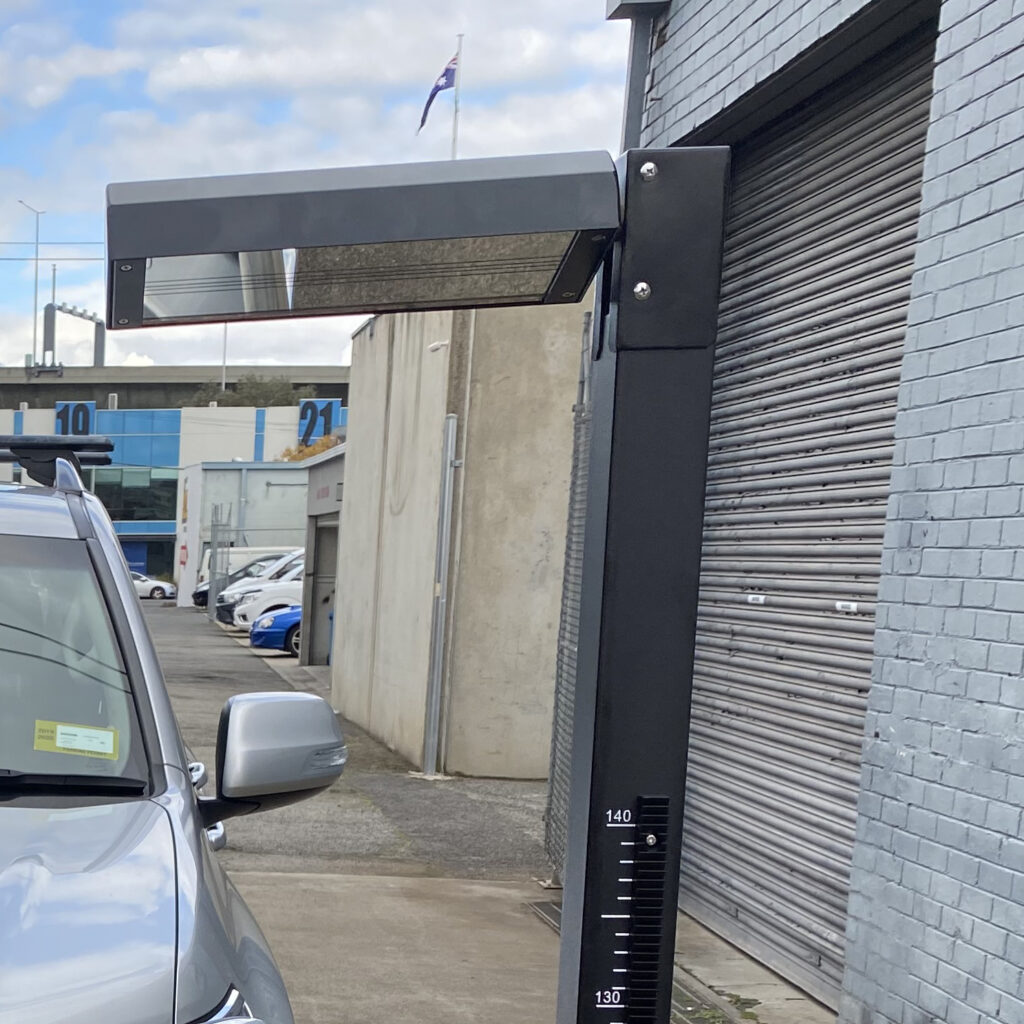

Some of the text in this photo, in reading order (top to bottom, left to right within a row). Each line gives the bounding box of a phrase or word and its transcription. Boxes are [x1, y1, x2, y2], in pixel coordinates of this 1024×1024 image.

[300, 400, 334, 447] 21
[606, 809, 632, 823] 140
[595, 990, 621, 1004] 130
